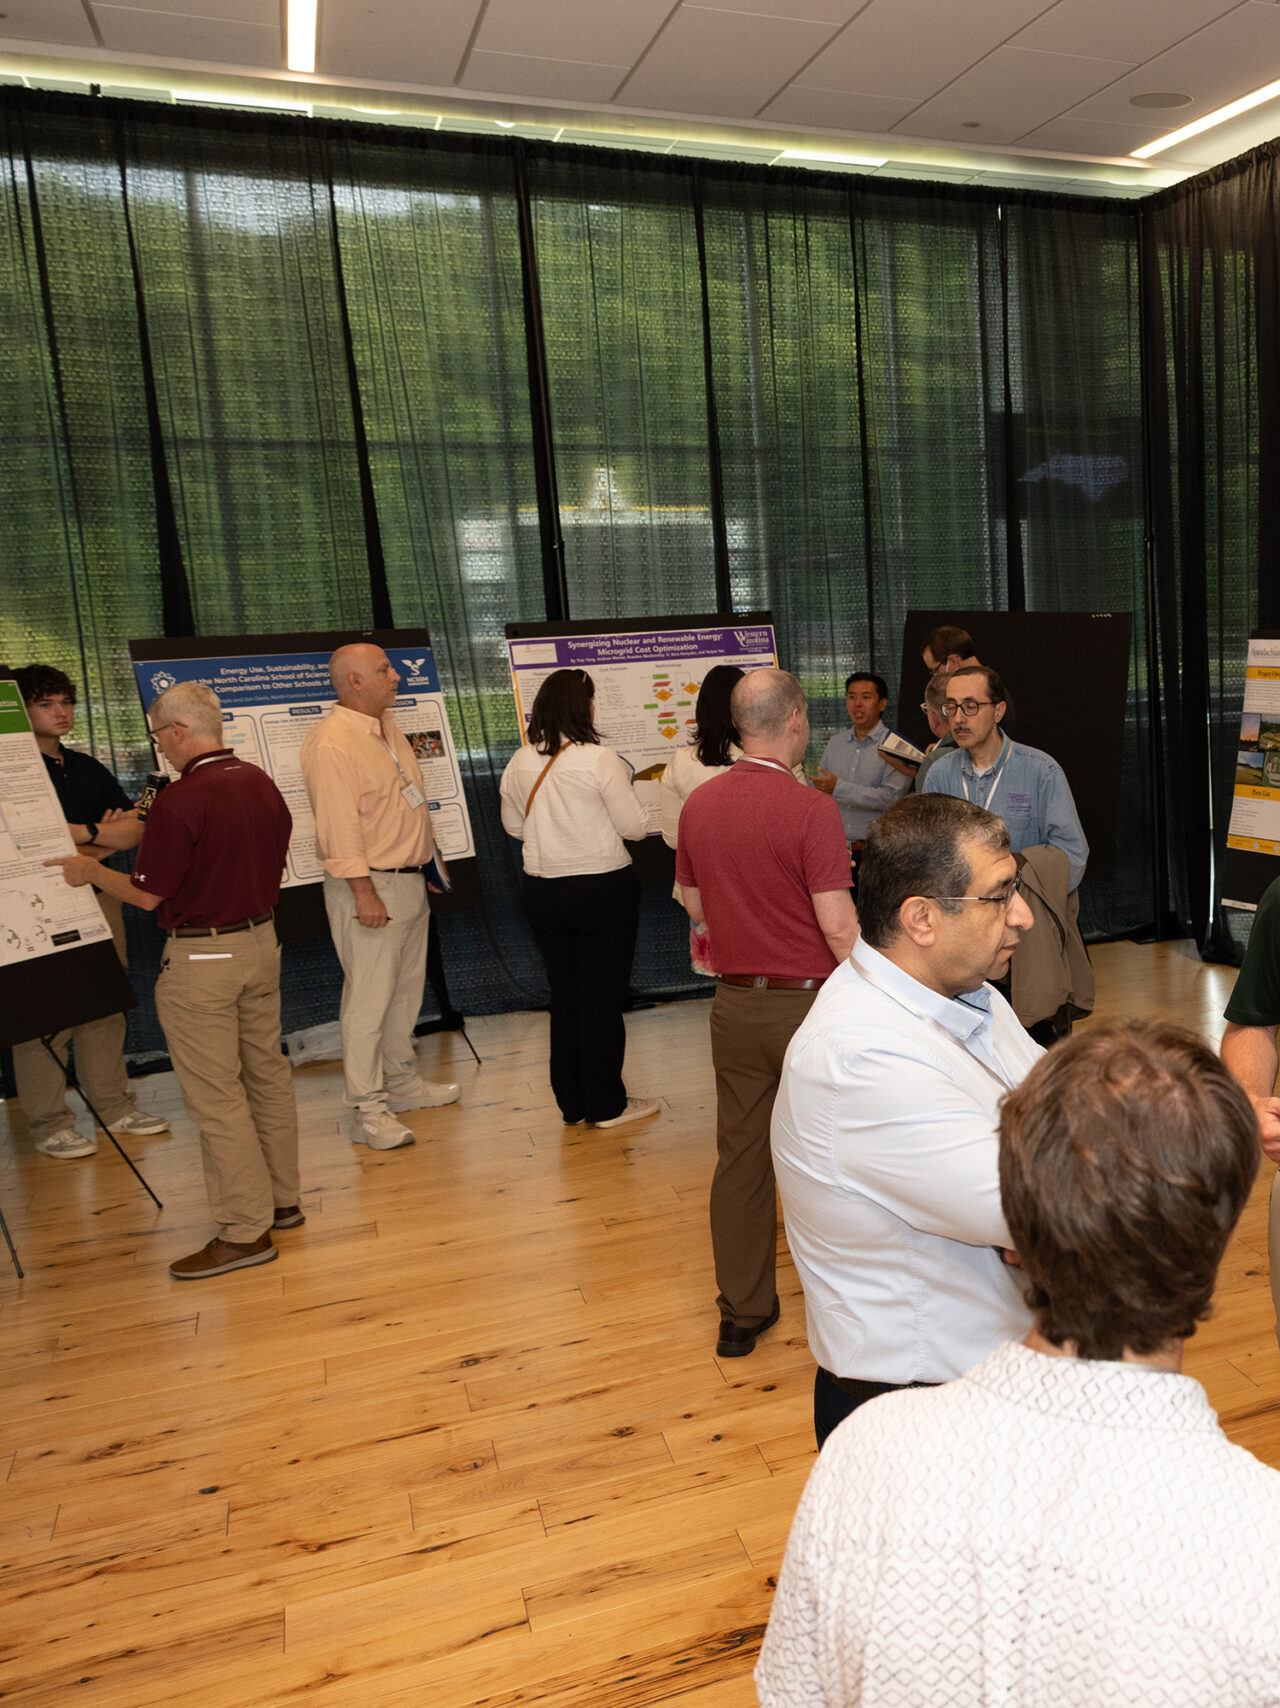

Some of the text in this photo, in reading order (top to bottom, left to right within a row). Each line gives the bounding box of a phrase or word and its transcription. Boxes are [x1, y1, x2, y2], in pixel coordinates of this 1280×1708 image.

[568, 640, 610, 650] Synergizing
[613, 638, 640, 646] Nuclear
[658, 635, 695, 643] Renewable
[698, 633, 723, 641] Energy:
[598, 643, 698, 656] Microgrid Cost Optimization
[214, 684, 261, 693] Comparison
